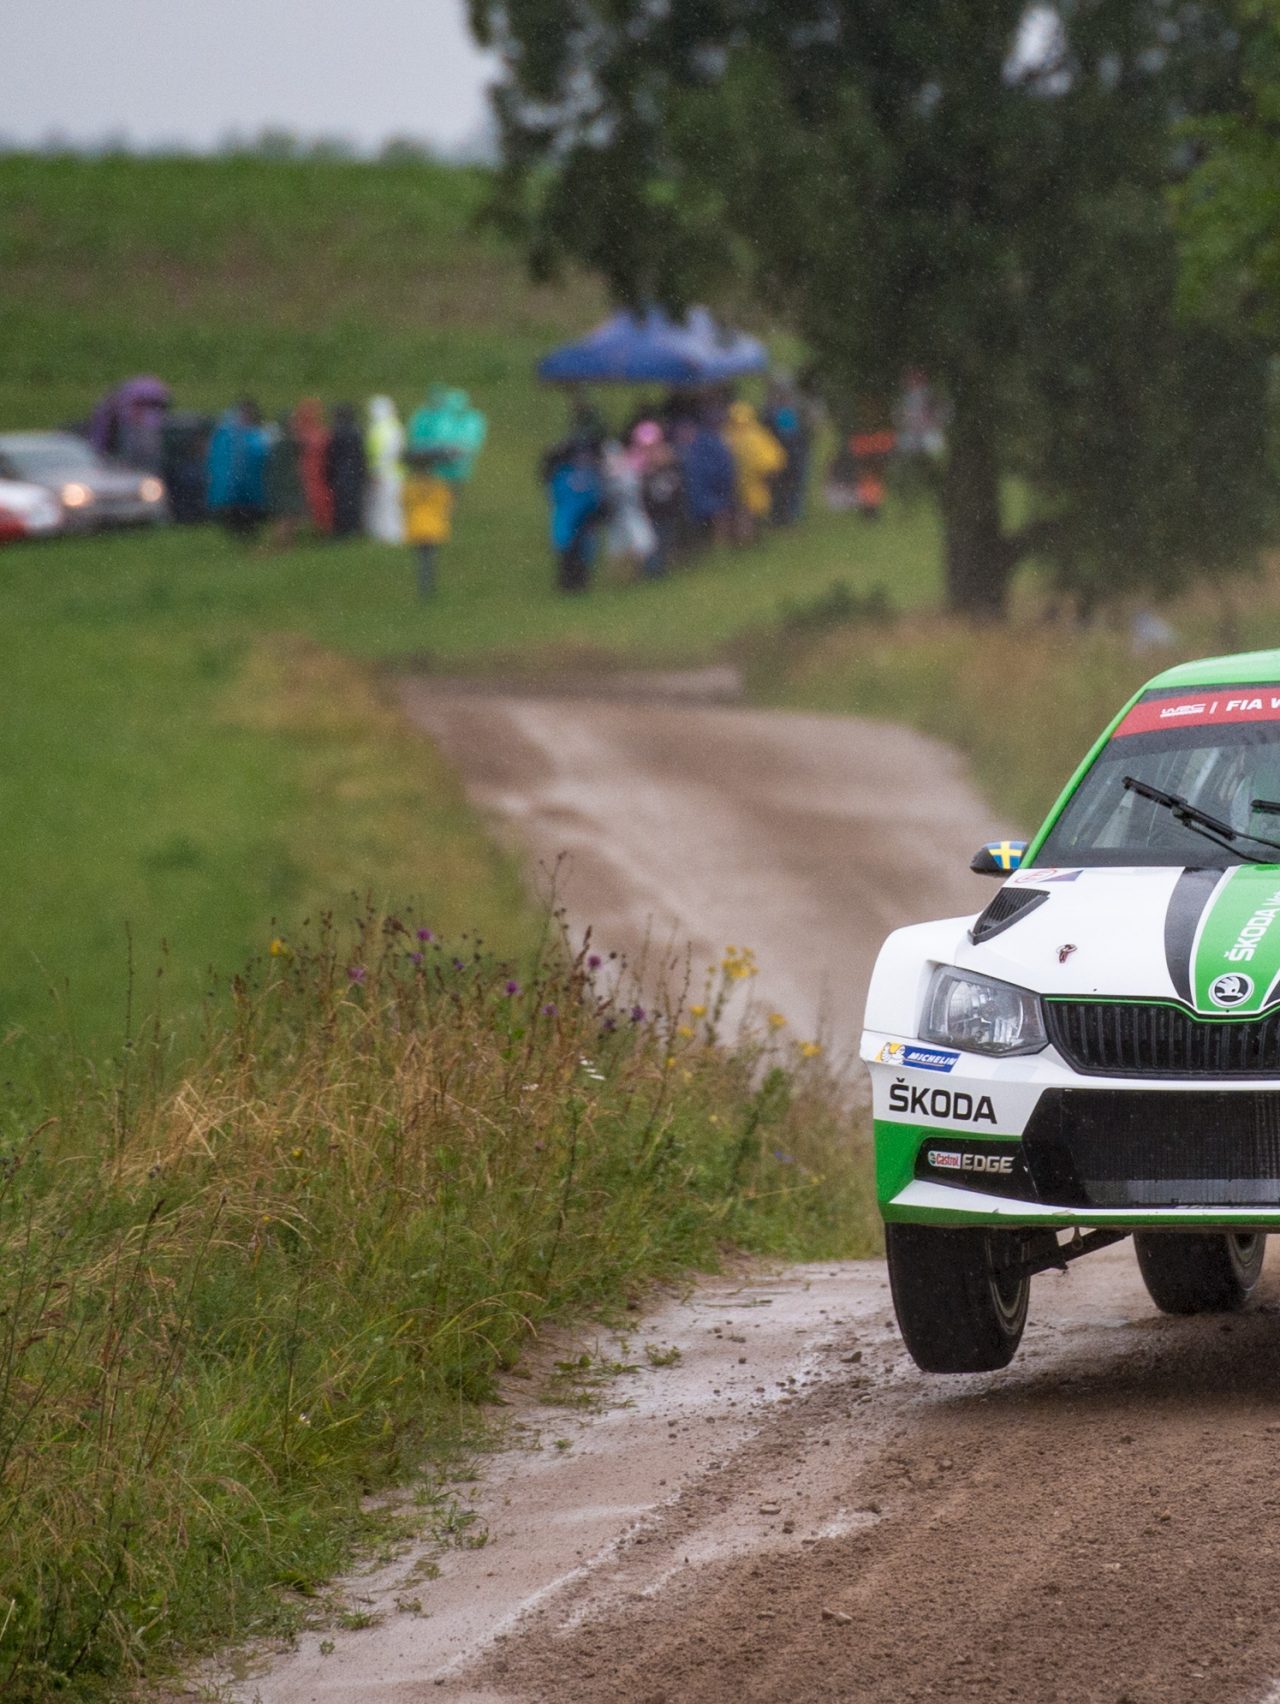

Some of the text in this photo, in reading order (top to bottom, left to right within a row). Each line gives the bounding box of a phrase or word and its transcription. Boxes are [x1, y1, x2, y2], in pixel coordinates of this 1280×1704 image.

[1225, 699, 1263, 711] FIA
[1224, 908, 1280, 961] ŠKODA
[908, 1052, 957, 1066] MICHELIN
[889, 1077, 998, 1125] ŠKODA
[935, 1153, 1015, 1174] Castrol EDGE
